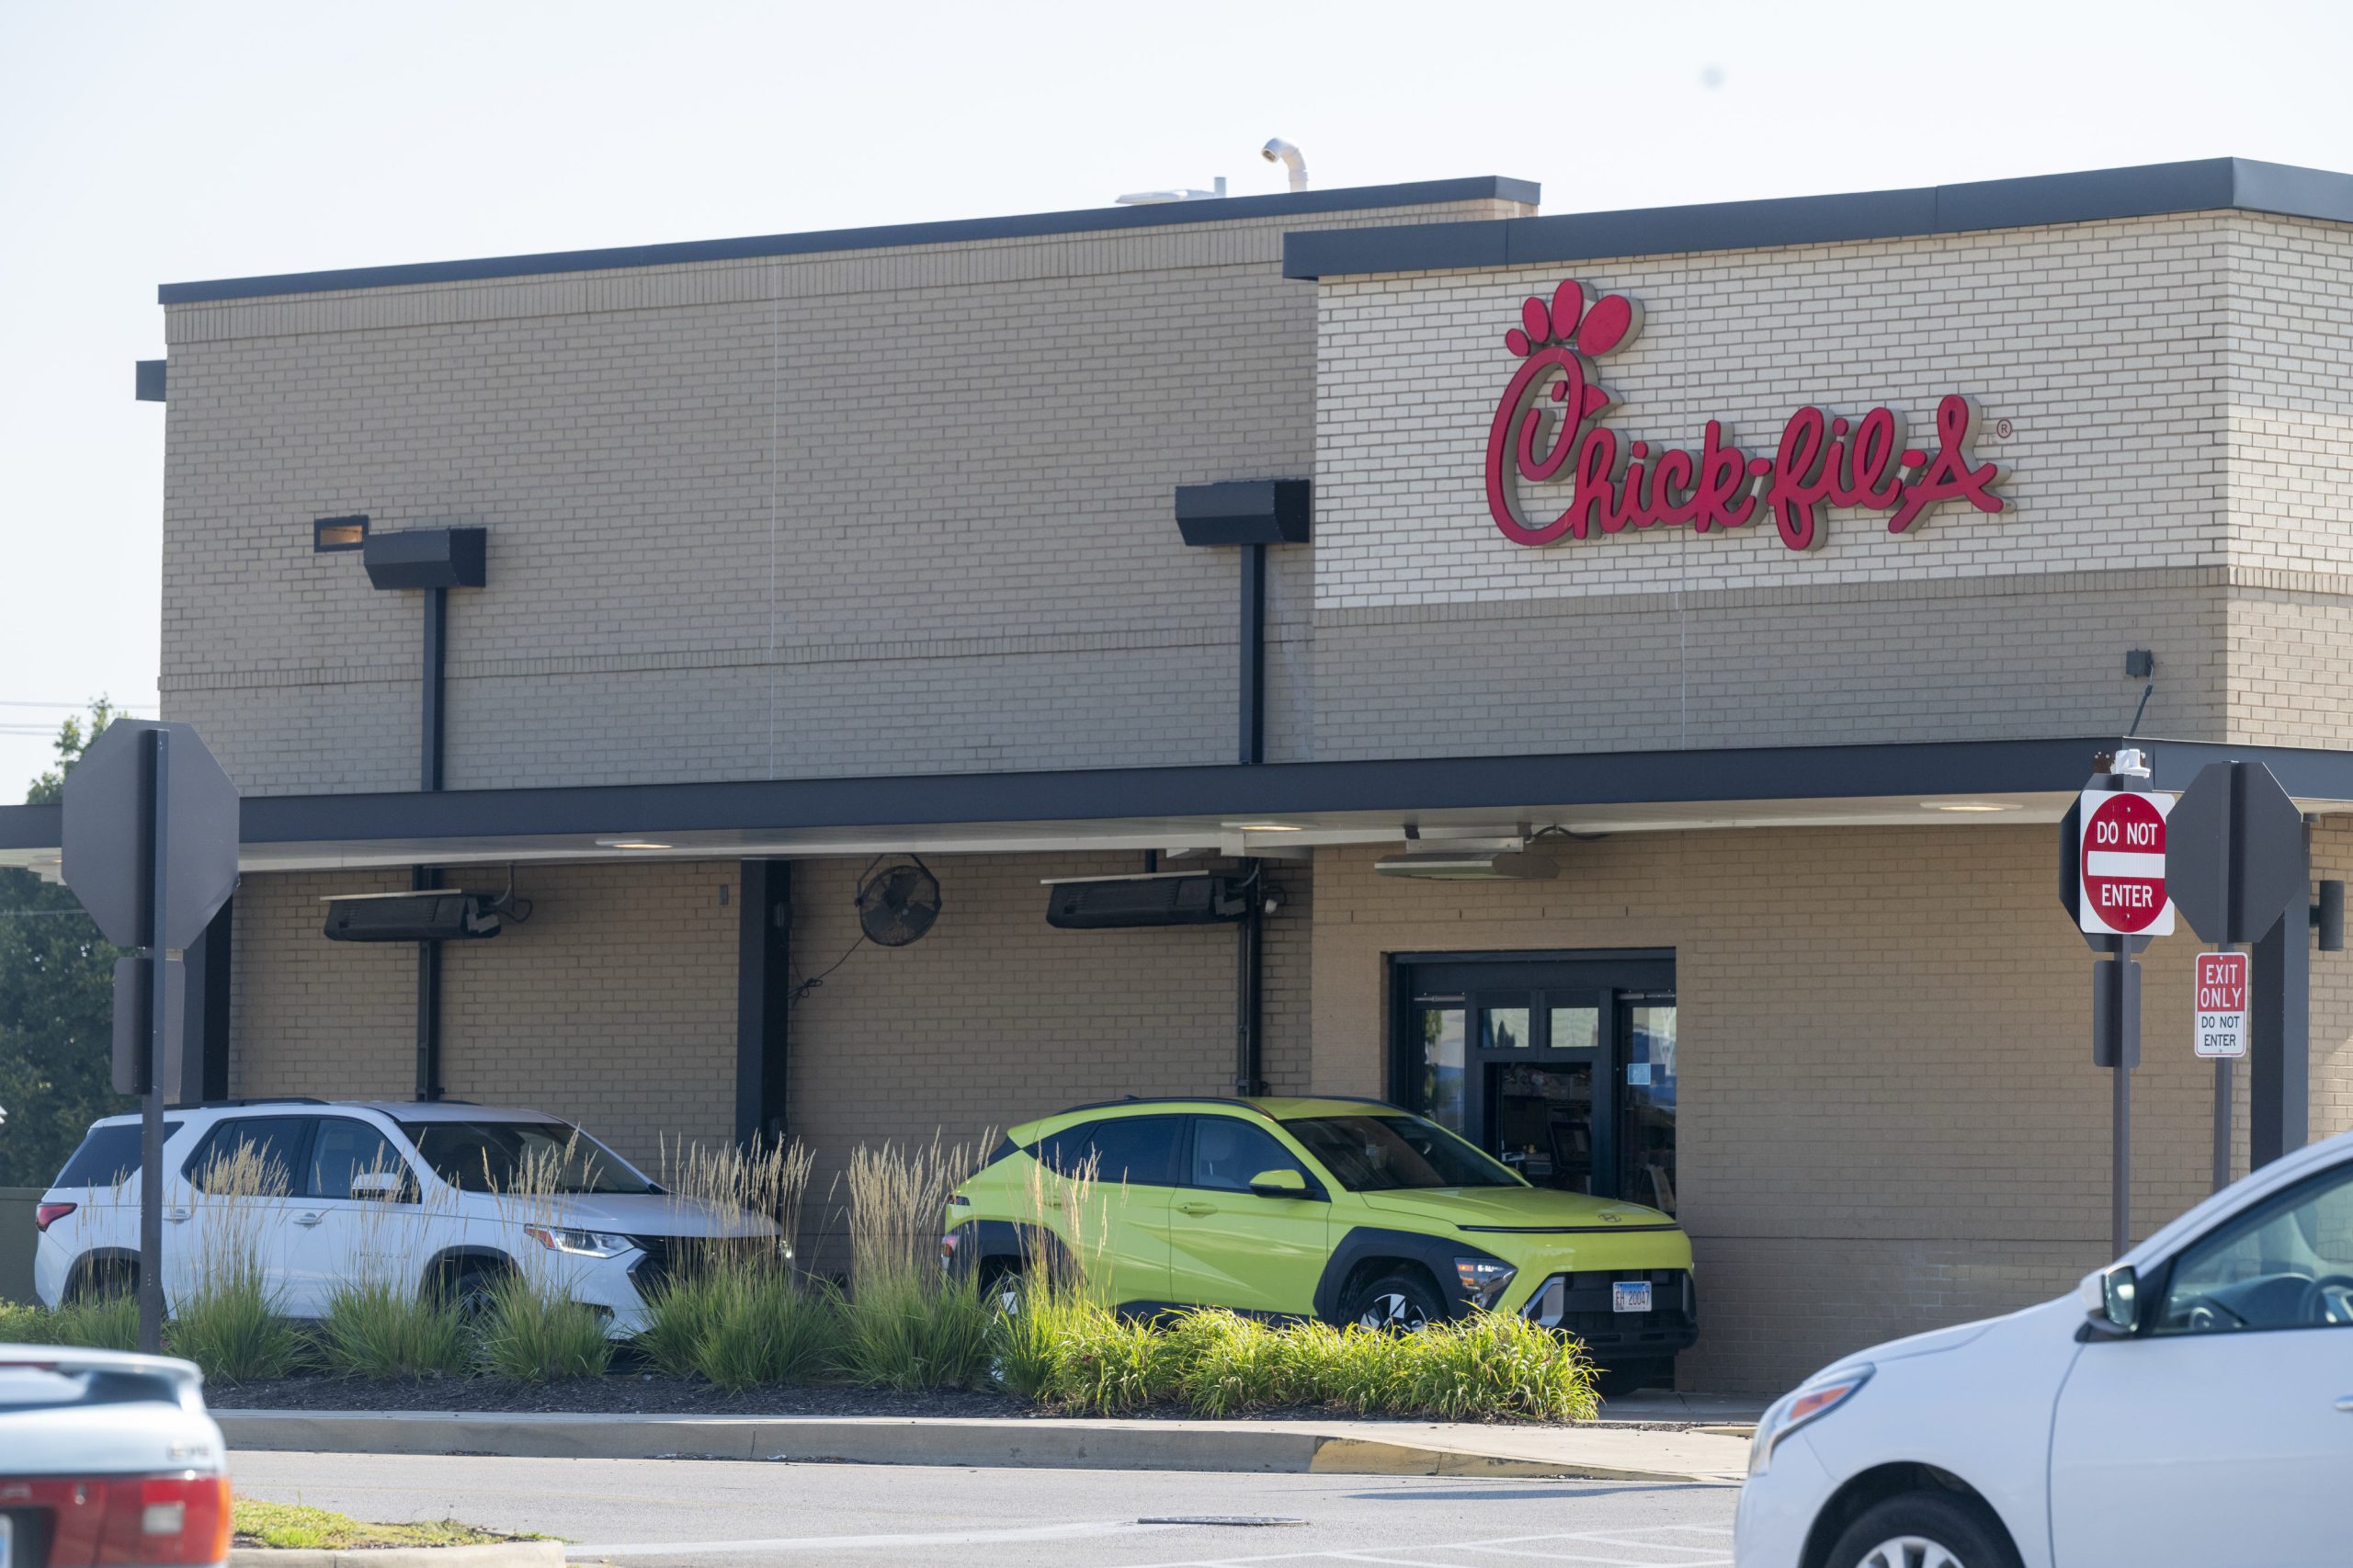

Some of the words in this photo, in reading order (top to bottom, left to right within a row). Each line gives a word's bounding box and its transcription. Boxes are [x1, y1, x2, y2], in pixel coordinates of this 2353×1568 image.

[1485, 346, 2006, 551] Chick-fil-A
[2097, 821, 2119, 845] DO
[2126, 823, 2158, 846] NOT
[2101, 883, 2154, 908] ENTER
[2206, 964, 2238, 984] EXIT
[2200, 987, 2243, 1008] ONLY
[2201, 1016, 2216, 1028] DO
[2220, 1016, 2240, 1028] NOT
[2204, 1034, 2236, 1047] ENTER
